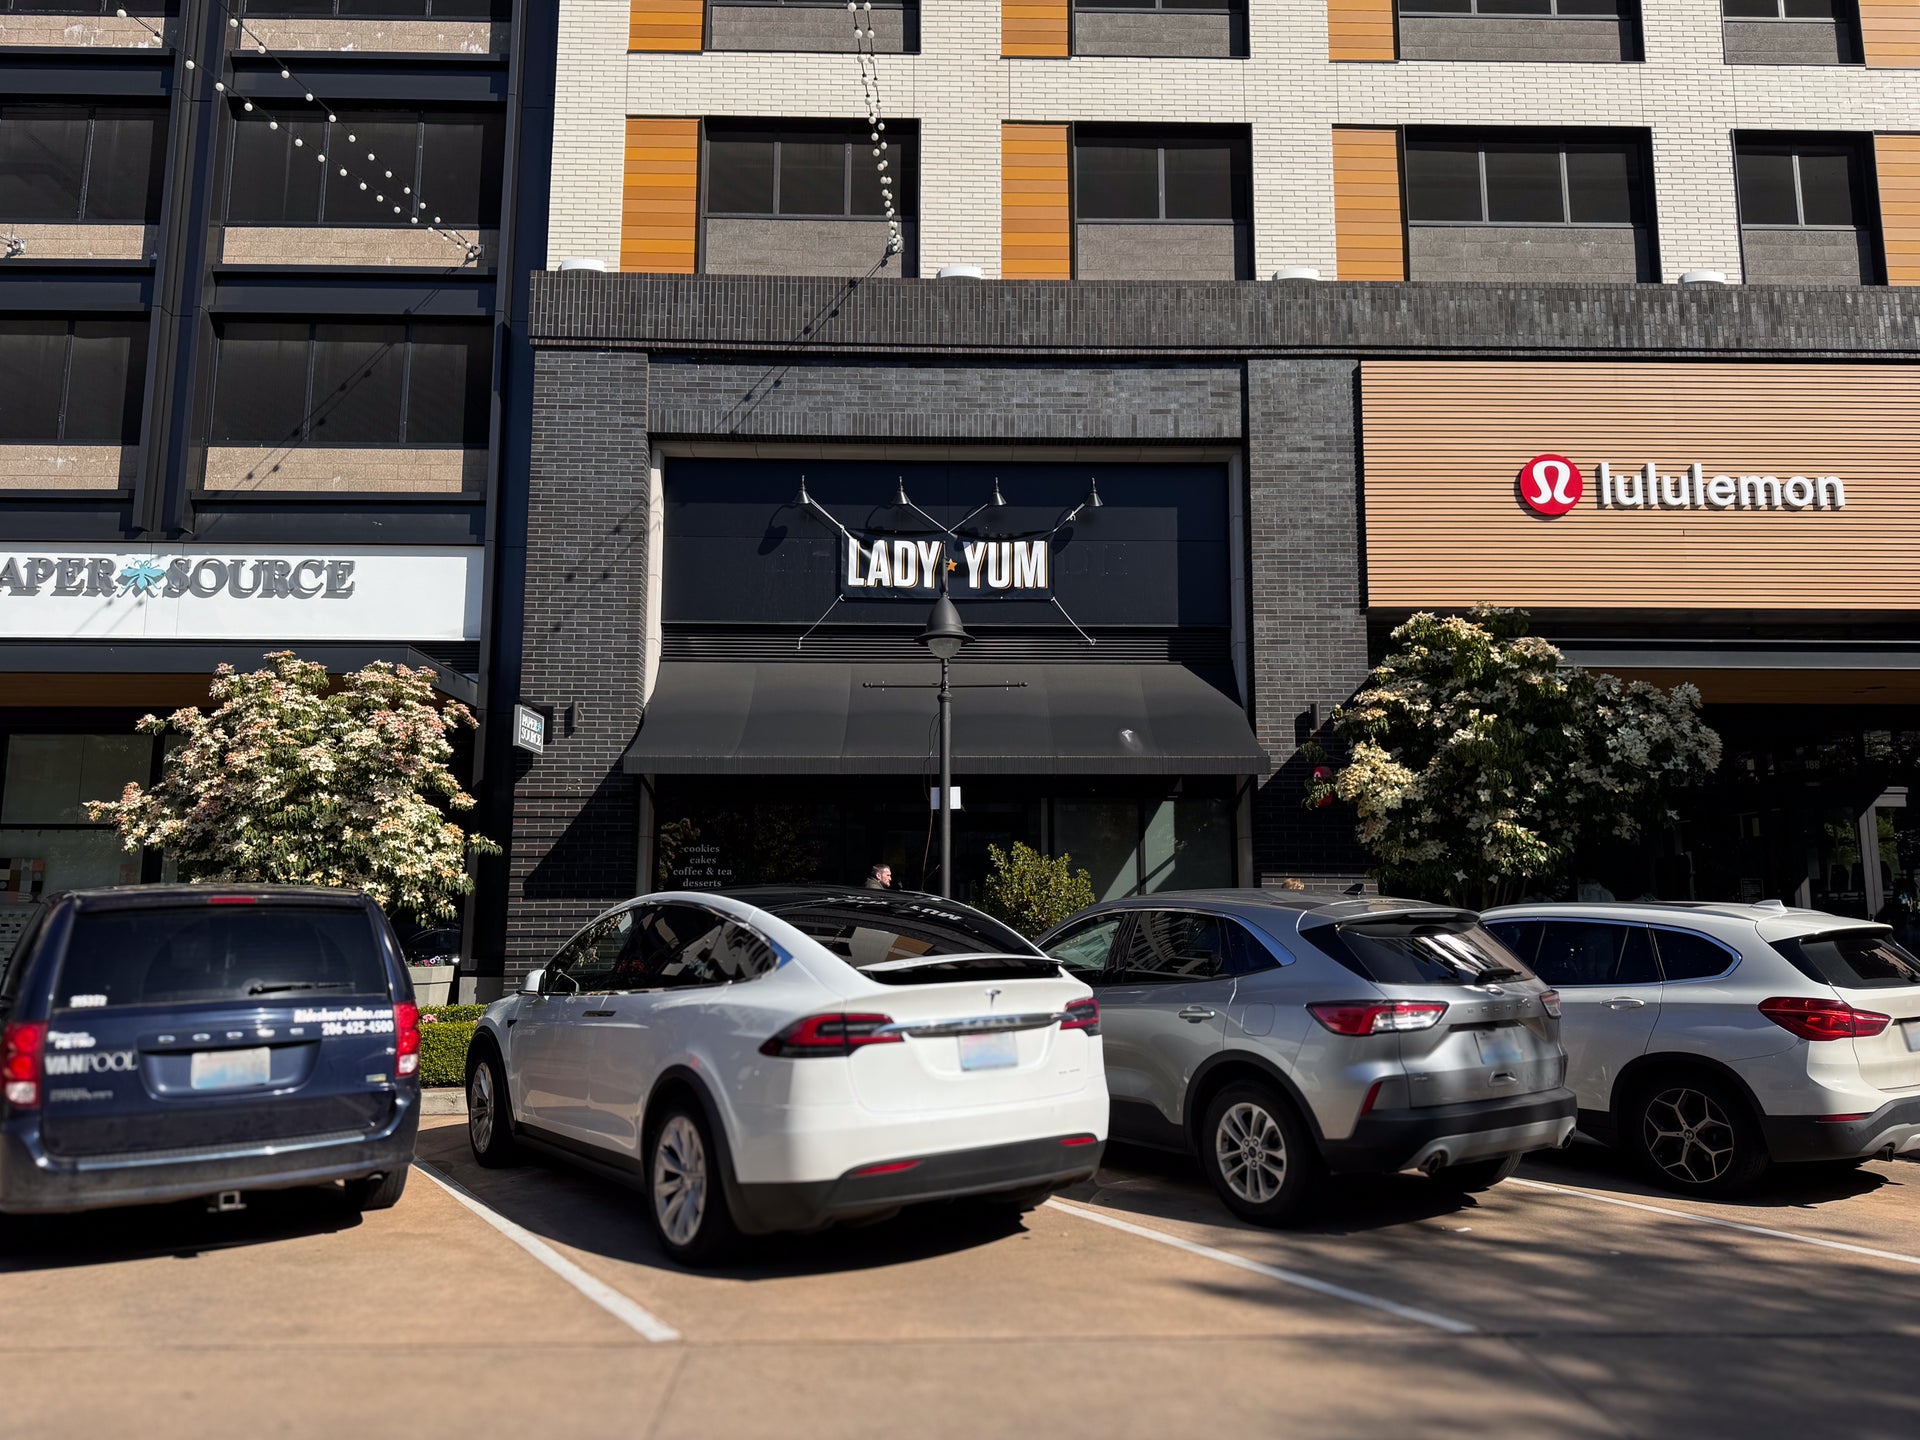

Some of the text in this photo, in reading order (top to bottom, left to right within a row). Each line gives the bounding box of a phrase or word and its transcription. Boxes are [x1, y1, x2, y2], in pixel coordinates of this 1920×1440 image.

[1598, 462, 1846, 509] lululemon
[848, 539, 943, 589] LADY
[963, 540, 1049, 589] YUM
[163, 557, 356, 599] SOURCE
[683, 843, 720, 853] cookies
[689, 855, 717, 864] cakes
[672, 866, 732, 876] coffee & tea
[682, 878, 722, 887] desserts
[321, 1020, 394, 1036] 206-625-4500
[45, 1052, 138, 1075] VANPOOL
